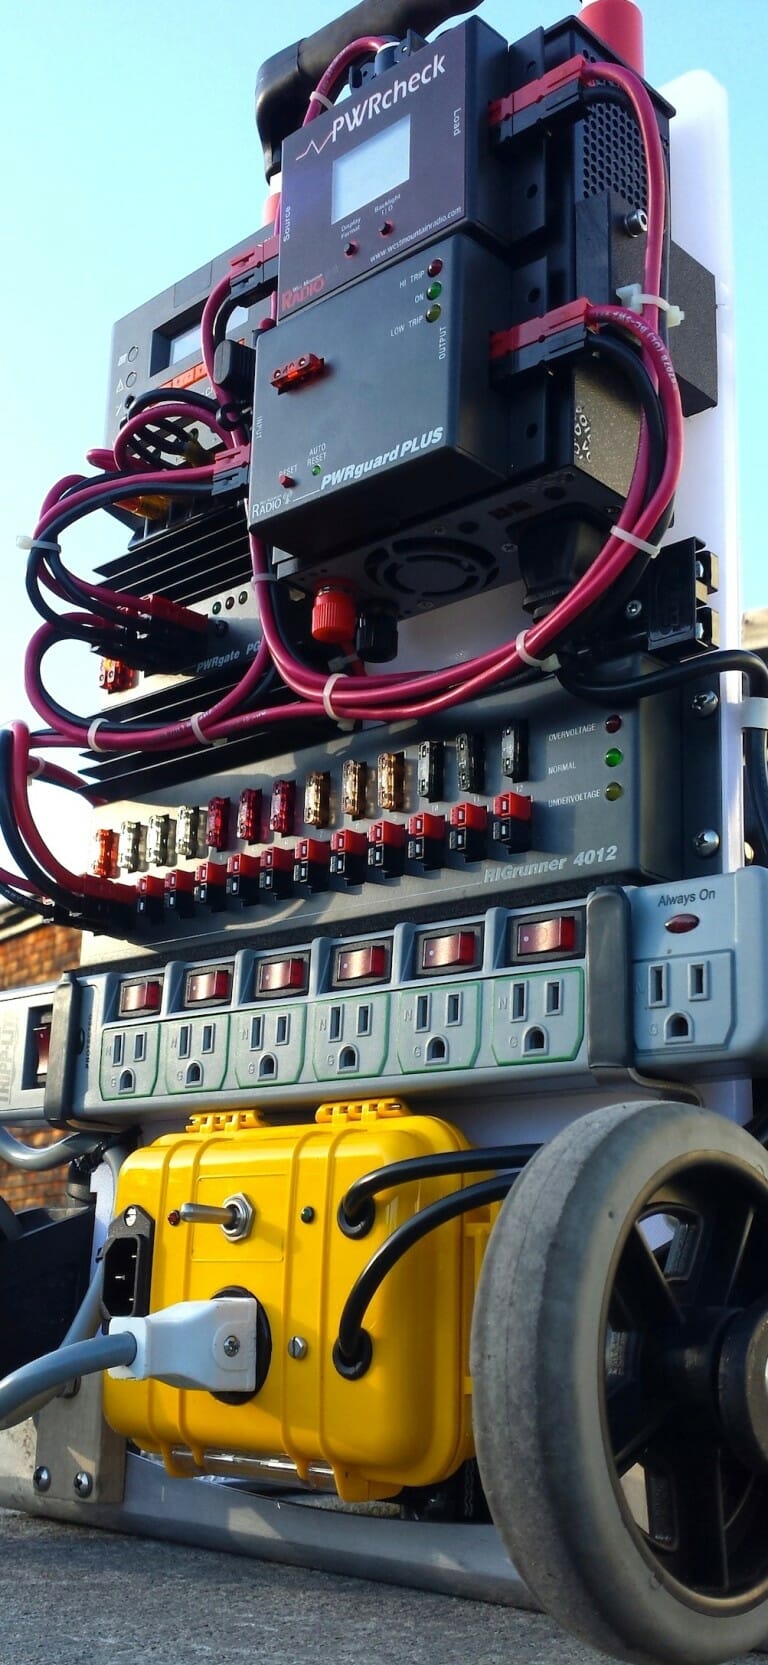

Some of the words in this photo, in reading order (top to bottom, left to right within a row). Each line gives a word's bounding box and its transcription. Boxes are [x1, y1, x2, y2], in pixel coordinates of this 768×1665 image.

[331, 53, 446, 144] PWRcheck
[452, 107, 462, 137] Load
[283, 205, 292, 243] Source
[410, 270, 425, 284] TRIP
[414, 293, 424, 304] ON
[390, 324, 405, 338] LOW
[408, 315, 424, 329] TRIP
[438, 326, 447, 360] OUTPUT
[306, 452, 327, 467] RESET
[309, 442, 326, 457] AUTO
[196, 649, 240, 673] PWRgate
[548, 723, 596, 742] OVERVOLTAGE
[548, 763, 577, 775] NORMAL
[548, 789, 601, 807] UNDERVOLTAGE
[573, 845, 618, 867] 4012
[657, 889, 697, 908] Always
[699, 888, 716, 902] On
